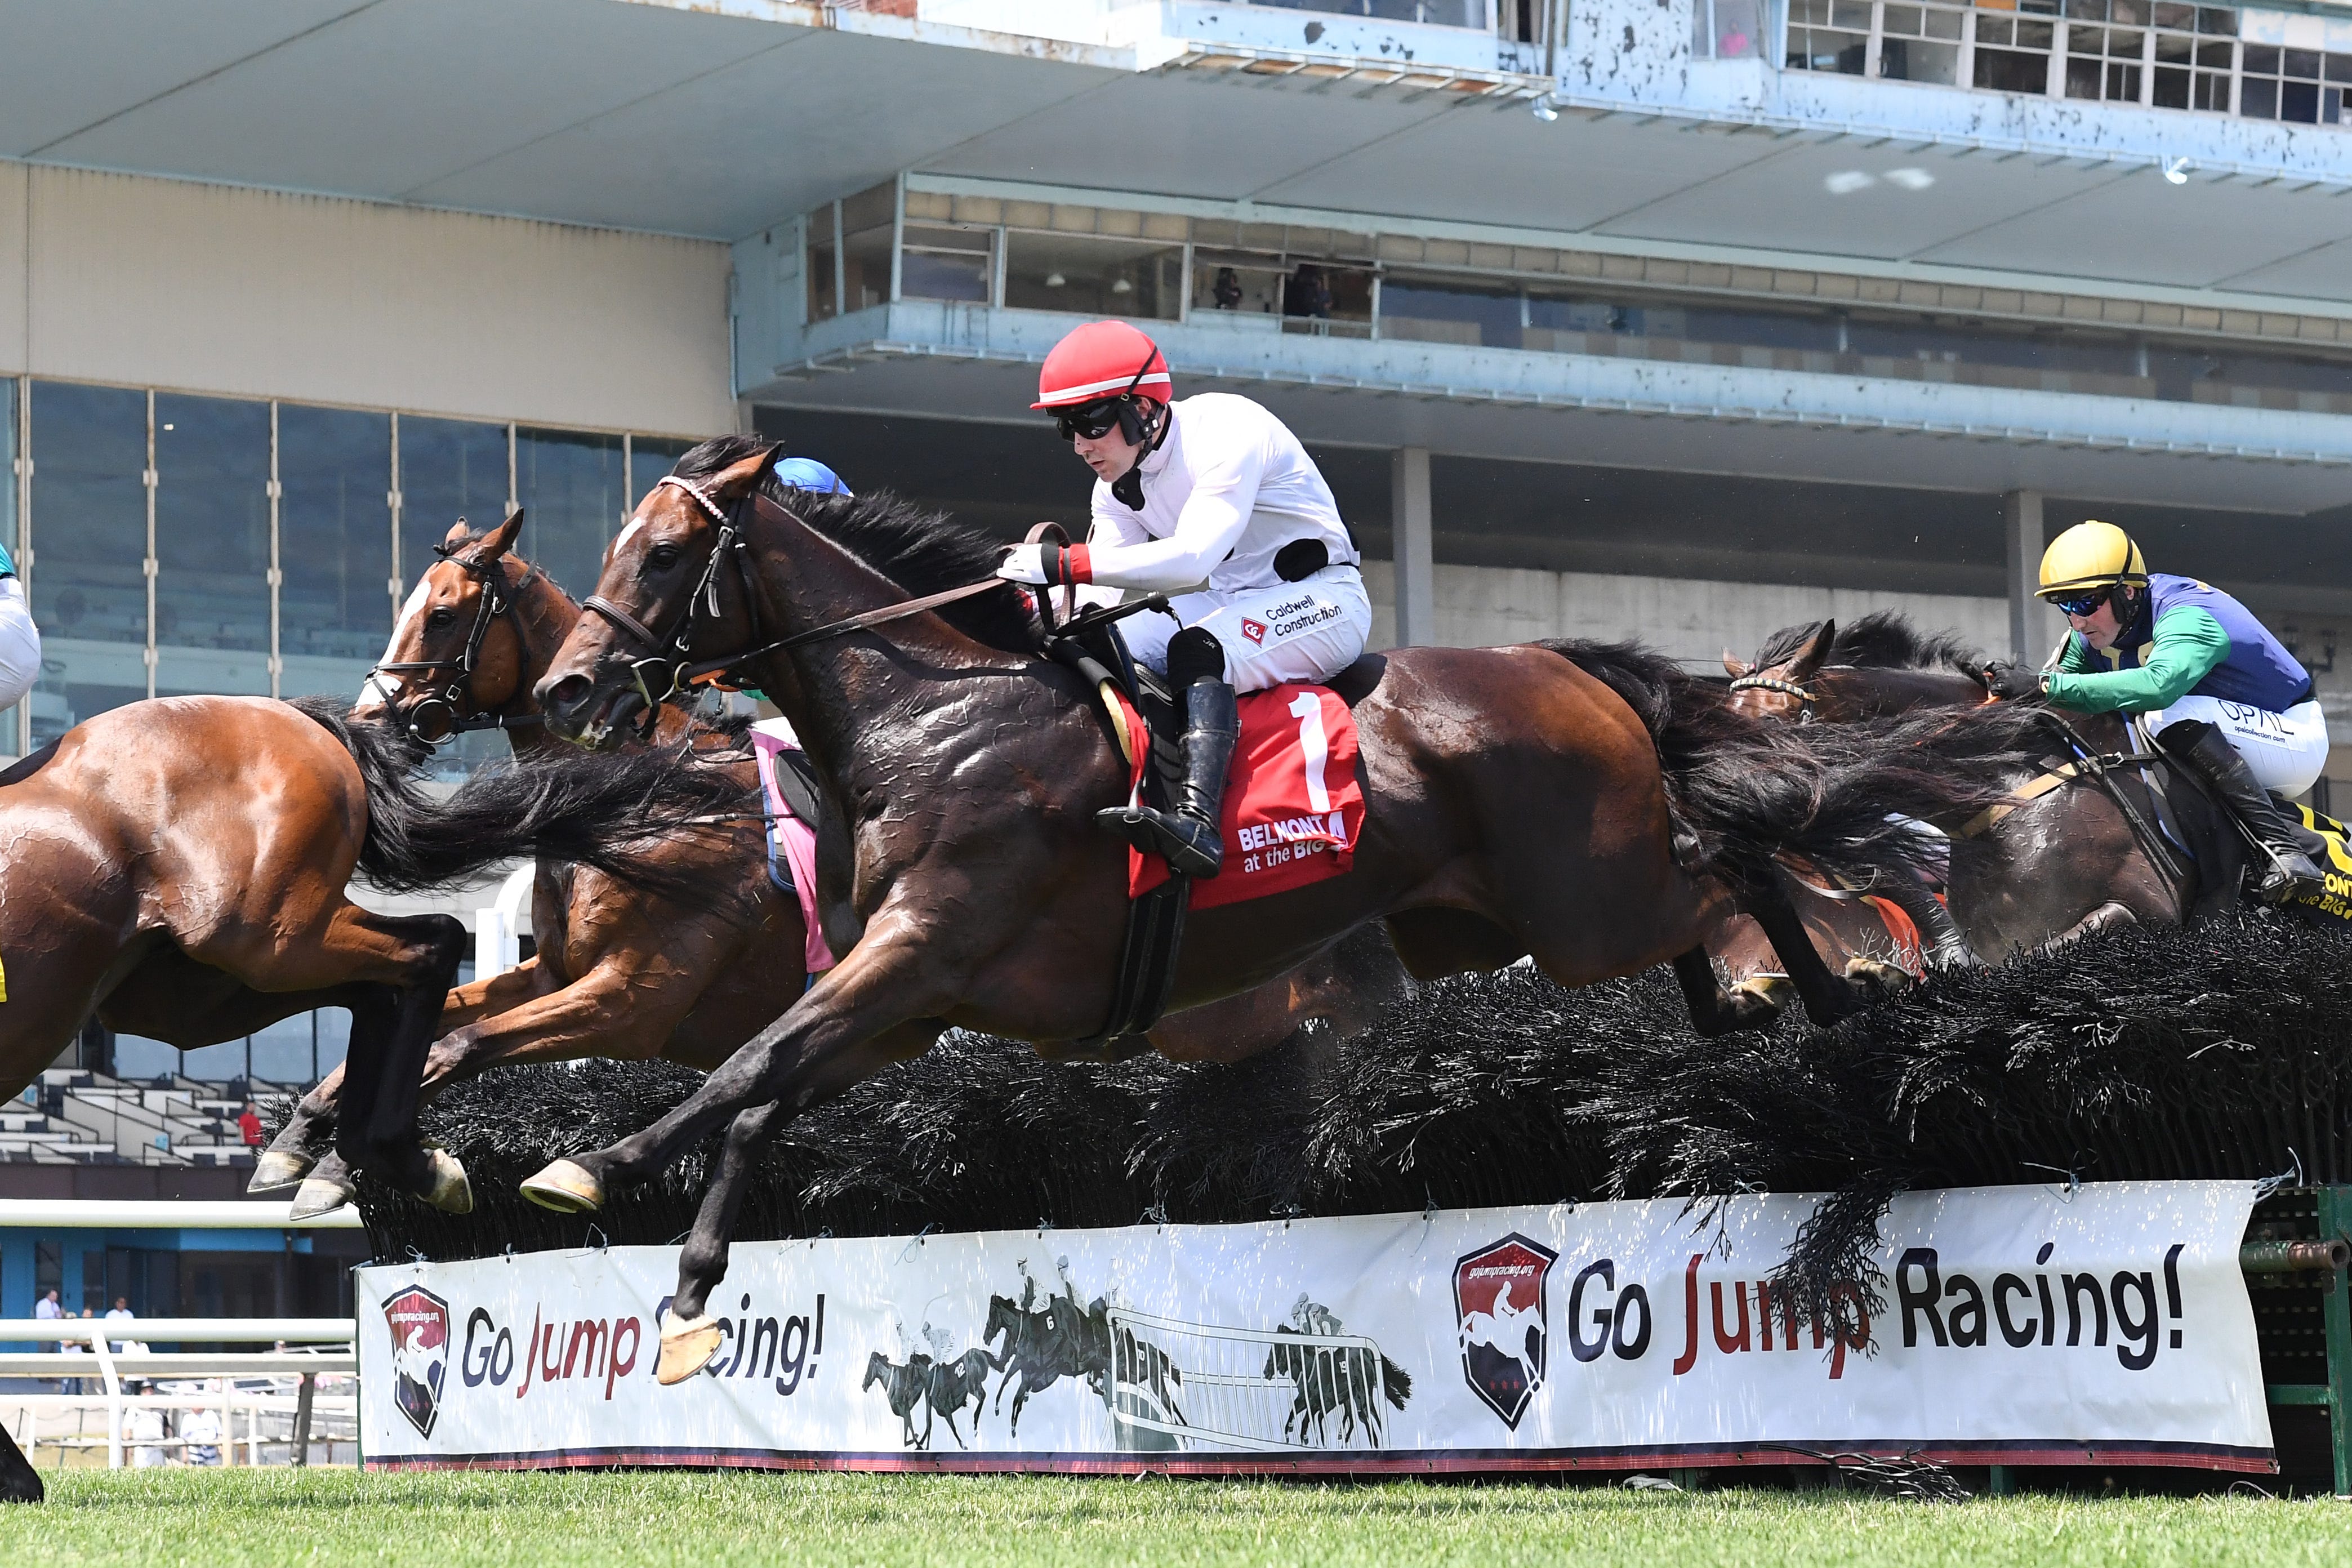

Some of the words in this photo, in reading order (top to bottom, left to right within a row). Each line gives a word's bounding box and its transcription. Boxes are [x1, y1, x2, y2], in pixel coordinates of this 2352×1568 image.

[1266, 595, 1315, 621] Caldwell
[1275, 604, 1342, 636] Construction
[1288, 692, 1331, 812] 1
[1238, 814, 1326, 852] BELMONT
[1244, 853, 1262, 873] at
[1266, 847, 1290, 867] the
[1293, 839, 1327, 860] BIG
[2319, 894, 2347, 916] BIG
[1468, 1263, 1536, 1280] gojumpracing.org
[1046, 1315, 1054, 1330] 6
[1567, 1258, 1651, 1362] Go
[1673, 1254, 1871, 1380] Jump
[1895, 1242, 2185, 1371] Racing!
[462, 1306, 514, 1388] Go
[516, 1301, 641, 1401] Jump
[651, 1293, 825, 1396] cing!
[954, 1362, 966, 1378] 12
